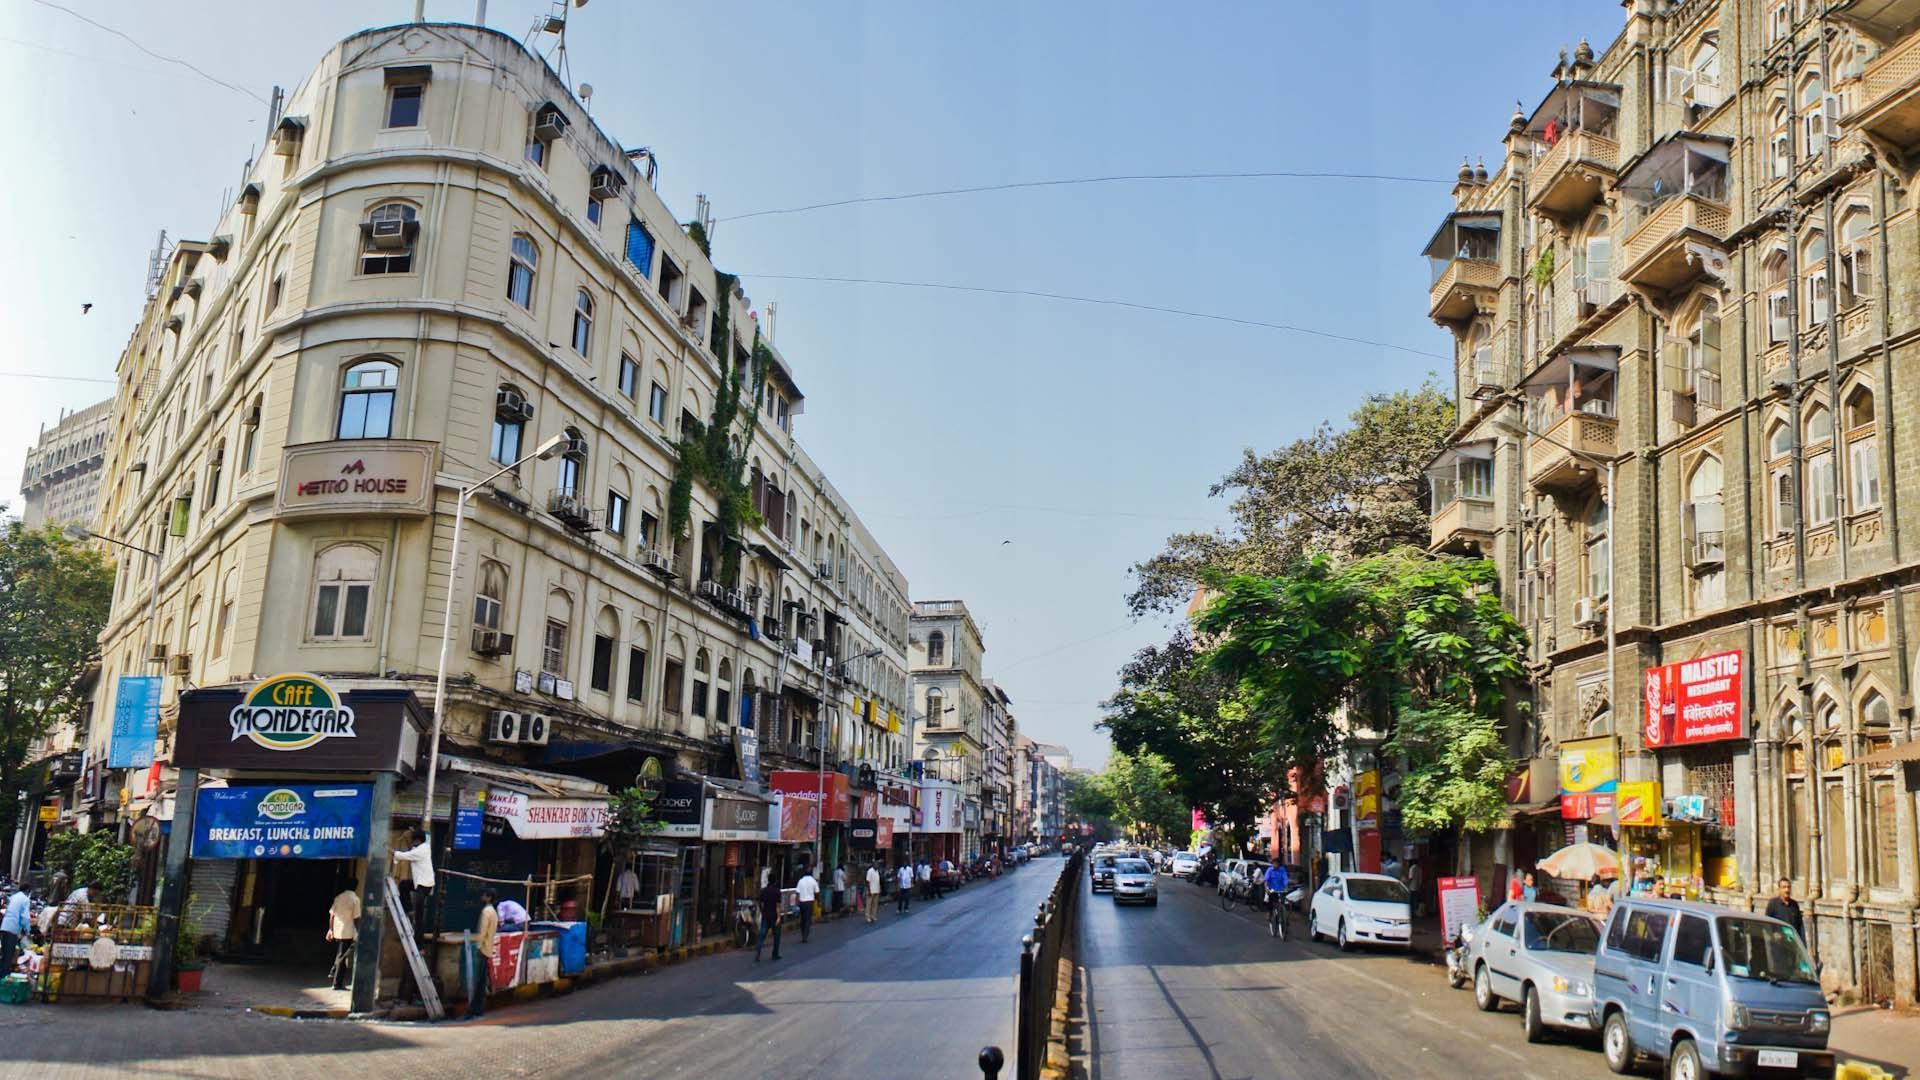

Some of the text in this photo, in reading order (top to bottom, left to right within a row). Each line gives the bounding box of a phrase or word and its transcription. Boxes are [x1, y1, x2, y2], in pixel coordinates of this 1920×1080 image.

[296, 478, 407, 496] METRO HOUSE
[273, 683, 315, 705] CAFE
[233, 708, 350, 733] MONDEGAR
[527, 807, 571, 823] SHANKAR
[313, 826, 354, 840] DINNER
